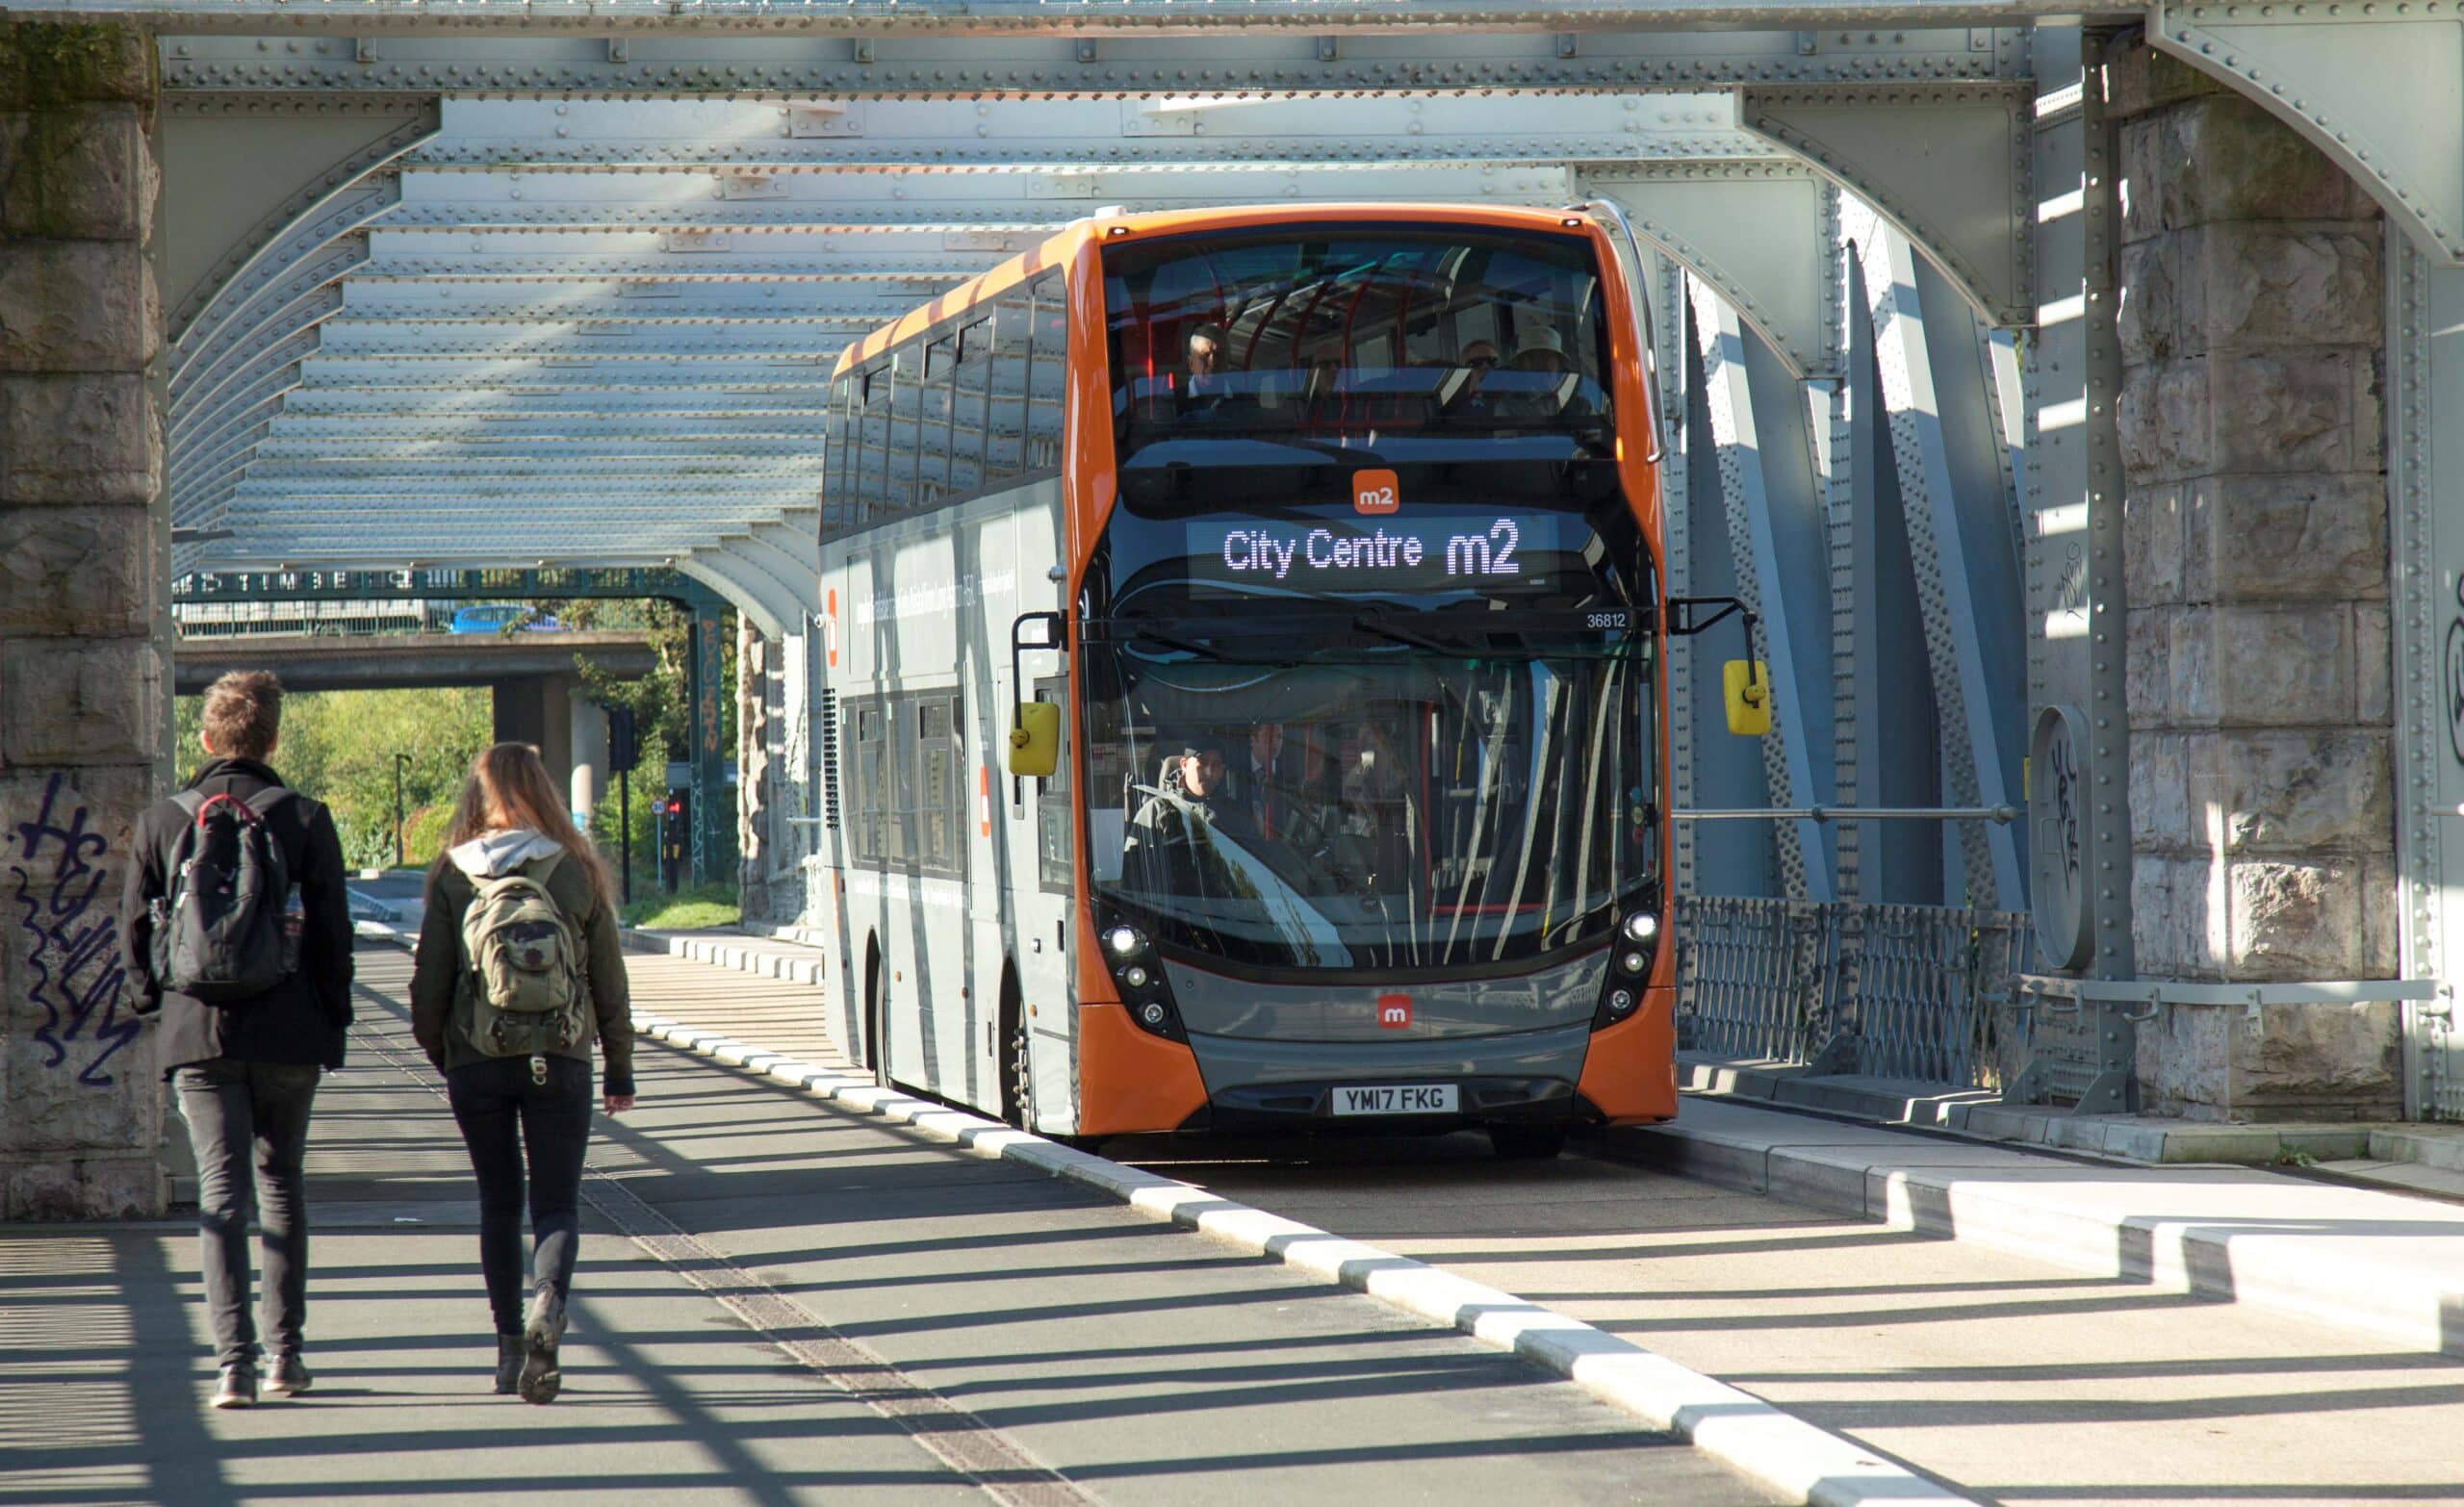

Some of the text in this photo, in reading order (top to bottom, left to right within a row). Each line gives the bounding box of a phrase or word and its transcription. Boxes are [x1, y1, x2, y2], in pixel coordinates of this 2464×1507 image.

[1359, 487, 1394, 505] m2
[1223, 518, 1519, 578] City Centre m2
[1587, 614, 1626, 628] 36812
[1384, 1008, 1406, 1022] m
[1346, 1088, 1444, 1111] YM17 FKG
